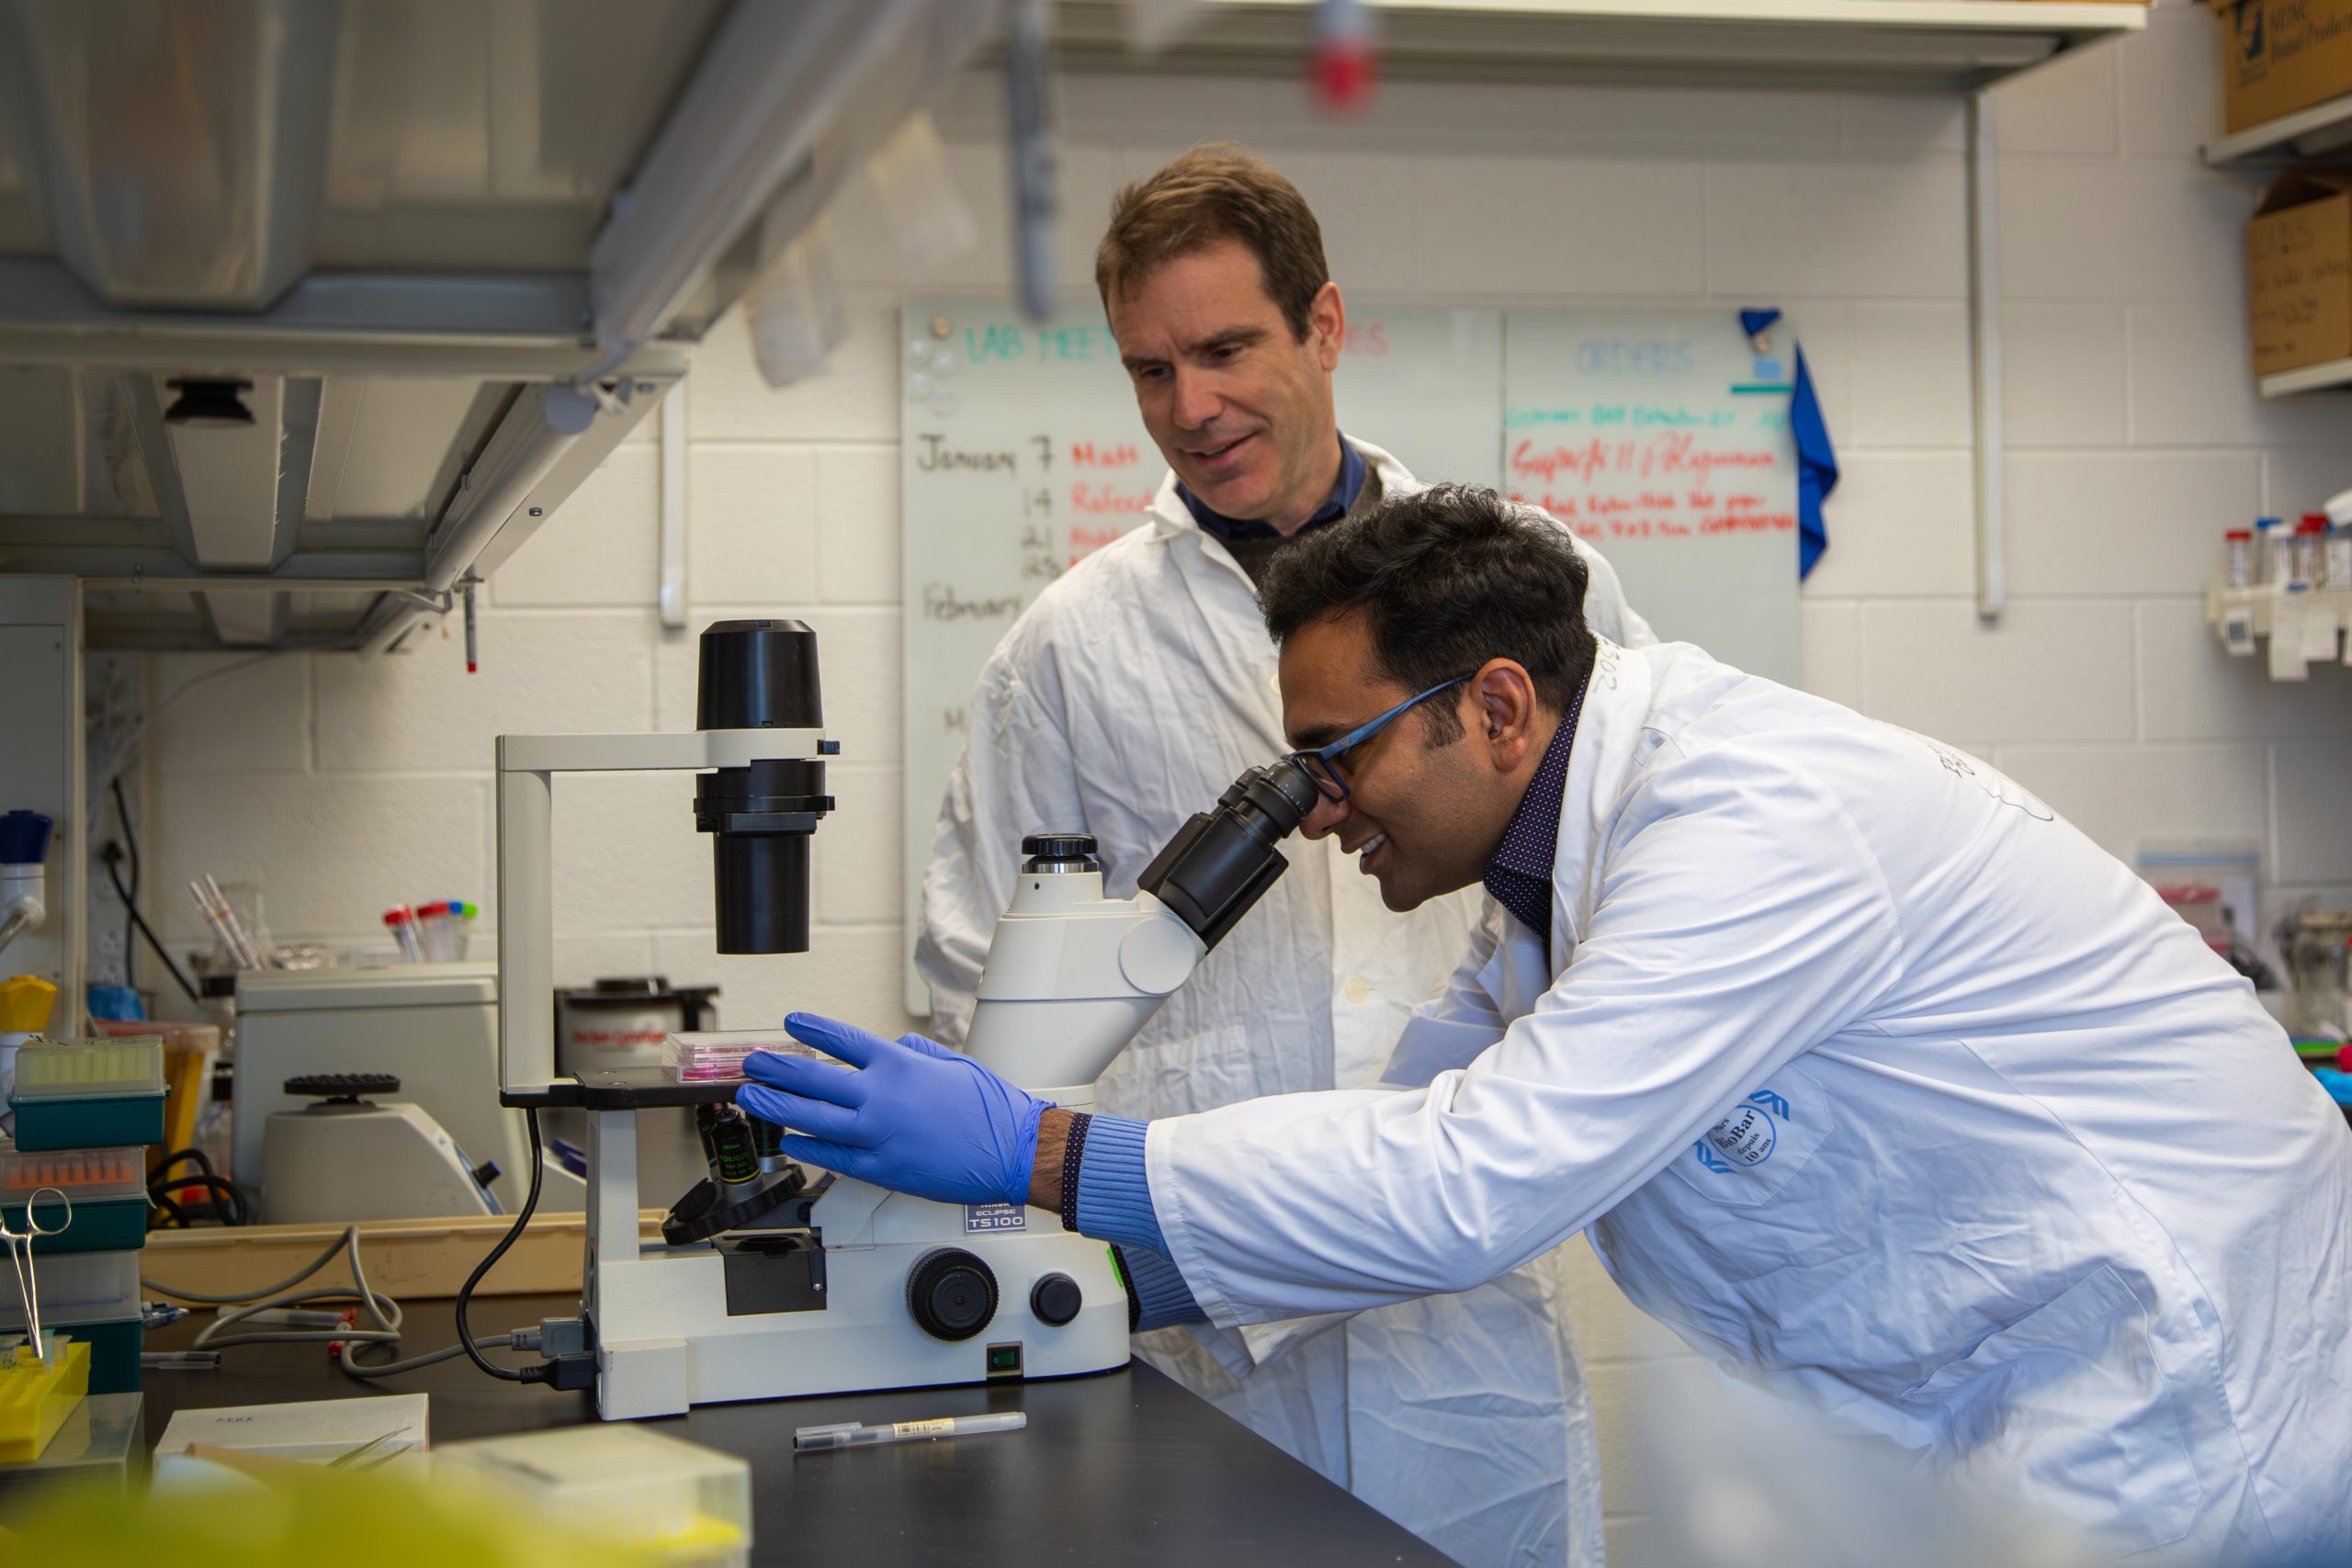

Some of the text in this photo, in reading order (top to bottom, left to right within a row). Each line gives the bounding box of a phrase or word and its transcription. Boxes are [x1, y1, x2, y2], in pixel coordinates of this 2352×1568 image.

[967, 323, 1026, 364] LAB
[917, 433, 1017, 477] January
[1030, 434, 1056, 471] 7
[1714, 1110, 1756, 1150] BioBar
[1736, 1132, 1760, 1156] depuis
[1745, 1137, 1772, 1163] 10 ans
[969, 1216, 1023, 1228] TS100
[976, 1208, 1017, 1216] ECLIPSE
